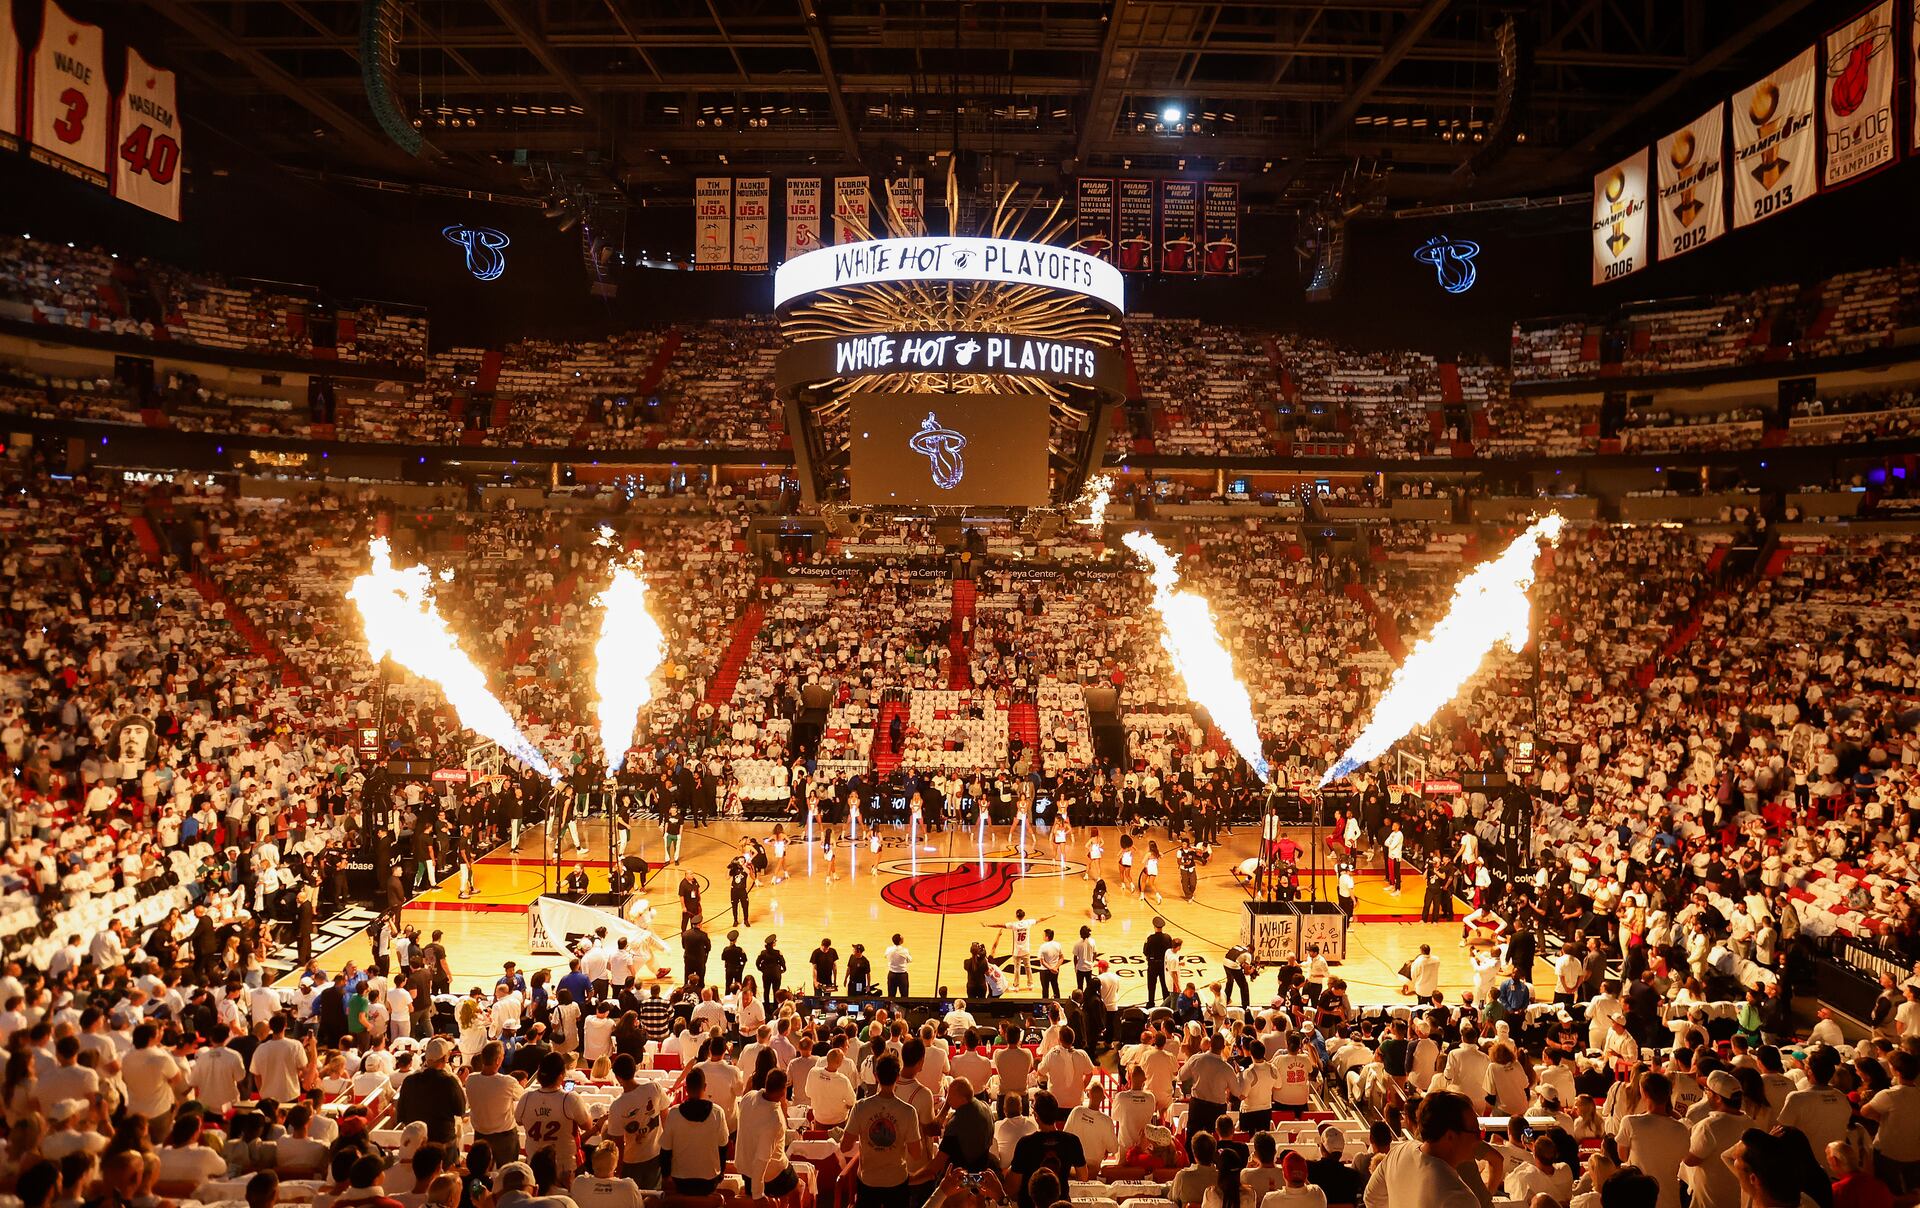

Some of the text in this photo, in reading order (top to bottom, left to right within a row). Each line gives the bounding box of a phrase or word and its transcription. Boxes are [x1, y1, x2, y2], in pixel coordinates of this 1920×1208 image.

[54, 51, 92, 86] WADE
[53, 87, 89, 145] 3
[128, 93, 173, 129] HASLEM
[1866, 107, 1889, 140] 06
[120, 123, 180, 185] 40
[1829, 145, 1889, 180] CHAMPIONS
[788, 181, 820, 189] DWYANE
[841, 188, 865, 196] JAMES
[700, 205, 726, 215] USA
[739, 205, 765, 215] USA
[791, 205, 816, 215] USA
[1754, 185, 1793, 219] 2013
[1674, 226, 1706, 253] 2012
[835, 243, 1092, 287] WHITE HOT PLAYOFFS
[1605, 258, 1633, 280] 2006
[836, 335, 1095, 379] WHITE HOT PLAYOFFS
[801, 567, 860, 577] Kaseya Center
[918, 568, 947, 577] Center
[1028, 569, 1058, 578] Center
[1087, 570, 1115, 579] Kaseya
[345, 861, 374, 870] nbase
[1260, 920, 1292, 937] WHITE
[1305, 922, 1339, 939] LET'S GO
[1017, 932, 1027, 942] 16
[1260, 936, 1285, 949] HOT
[1286, 1069, 1306, 1084] 22
[534, 1106, 552, 1117] LOVE
[527, 1120, 561, 1142] 42
